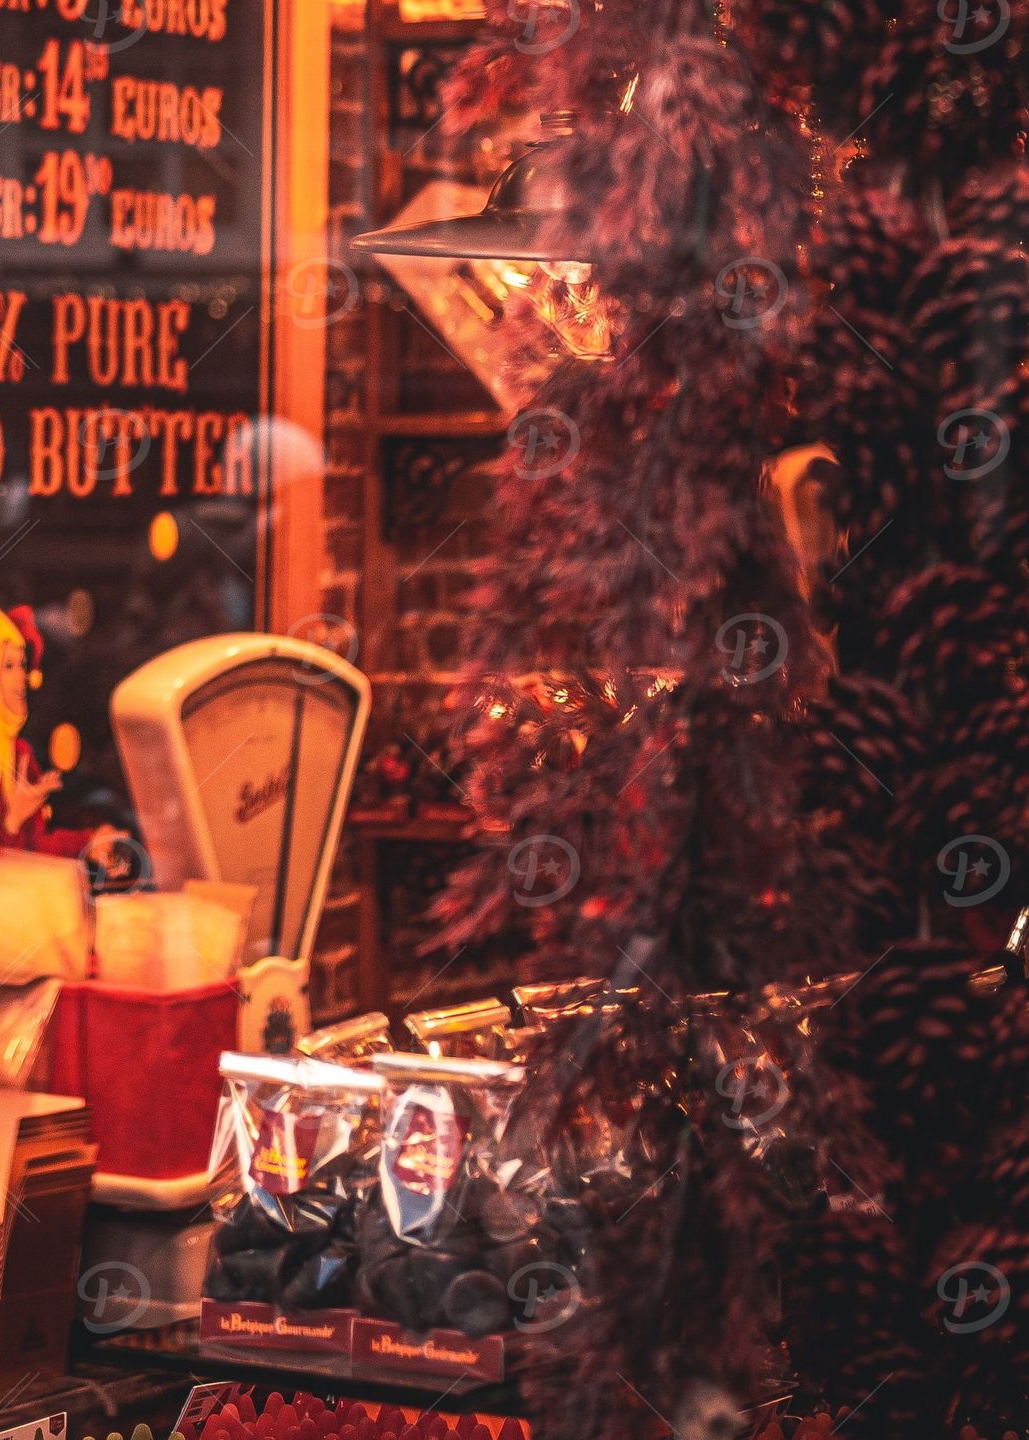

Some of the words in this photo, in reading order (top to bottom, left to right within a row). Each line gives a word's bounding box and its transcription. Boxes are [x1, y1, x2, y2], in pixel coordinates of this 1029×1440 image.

[112, 75, 223, 149] EUROS
[110, 189, 217, 255] EUROS
[51, 296, 192, 392] PURE
[30, 402, 253, 498] BUTTER
